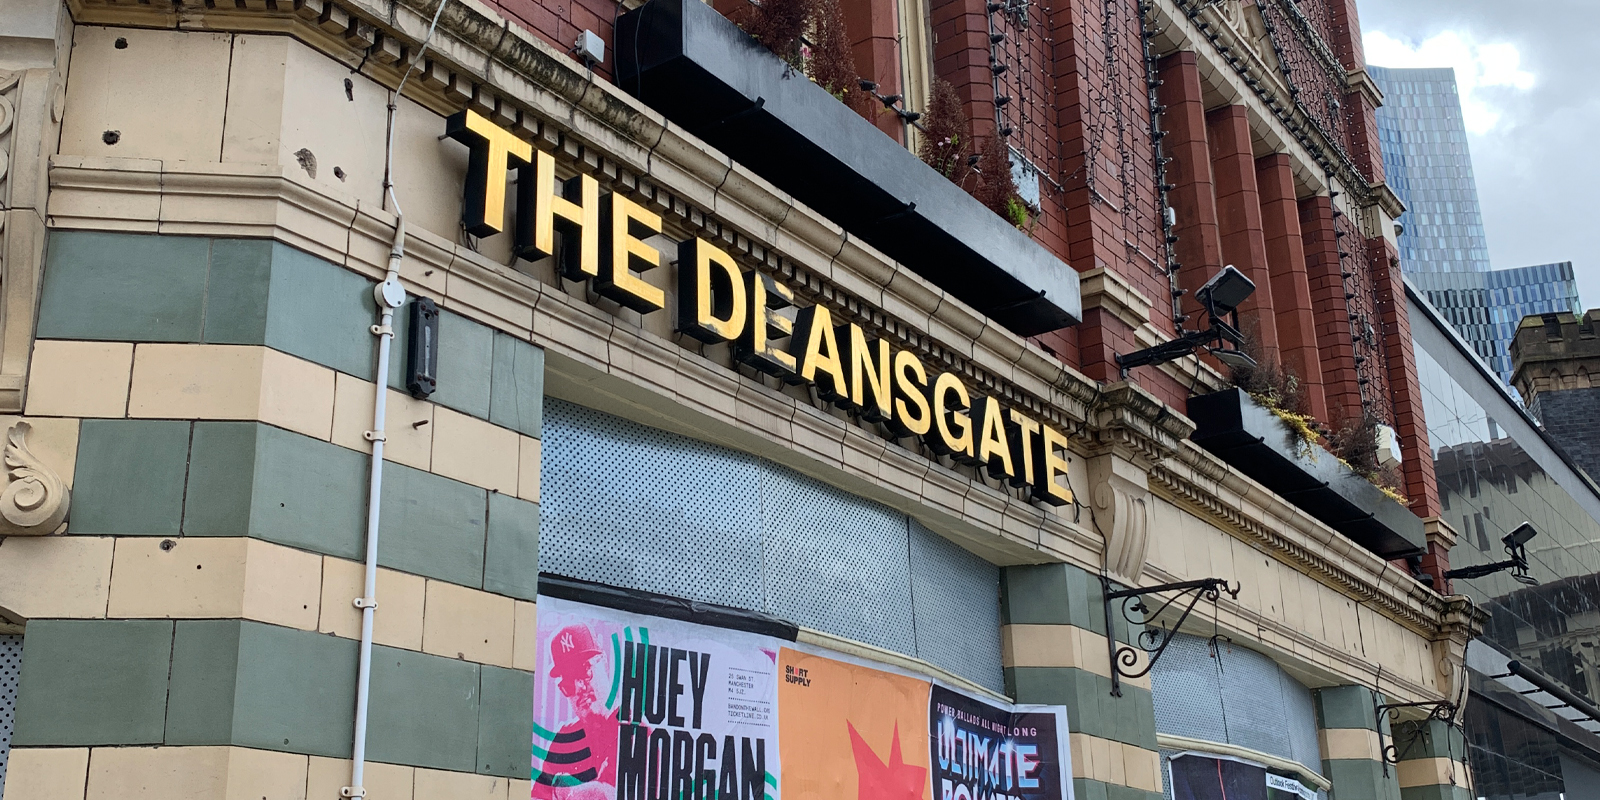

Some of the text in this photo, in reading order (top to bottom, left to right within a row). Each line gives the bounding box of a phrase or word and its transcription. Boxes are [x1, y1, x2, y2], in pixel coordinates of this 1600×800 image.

[463, 108, 1074, 506] THE DEANSGATE
[619, 640, 711, 730] HUEY
[728, 681, 754, 689] MANCHESTER
[785, 664, 809, 678] SHRT
[785, 674, 812, 688] SUPPLY
[937, 702, 1038, 737] POWER BALLADS ALL NIGHT LONG
[616, 723, 766, 800] MORGAN
[937, 719, 1041, 792] ULTIMATE
